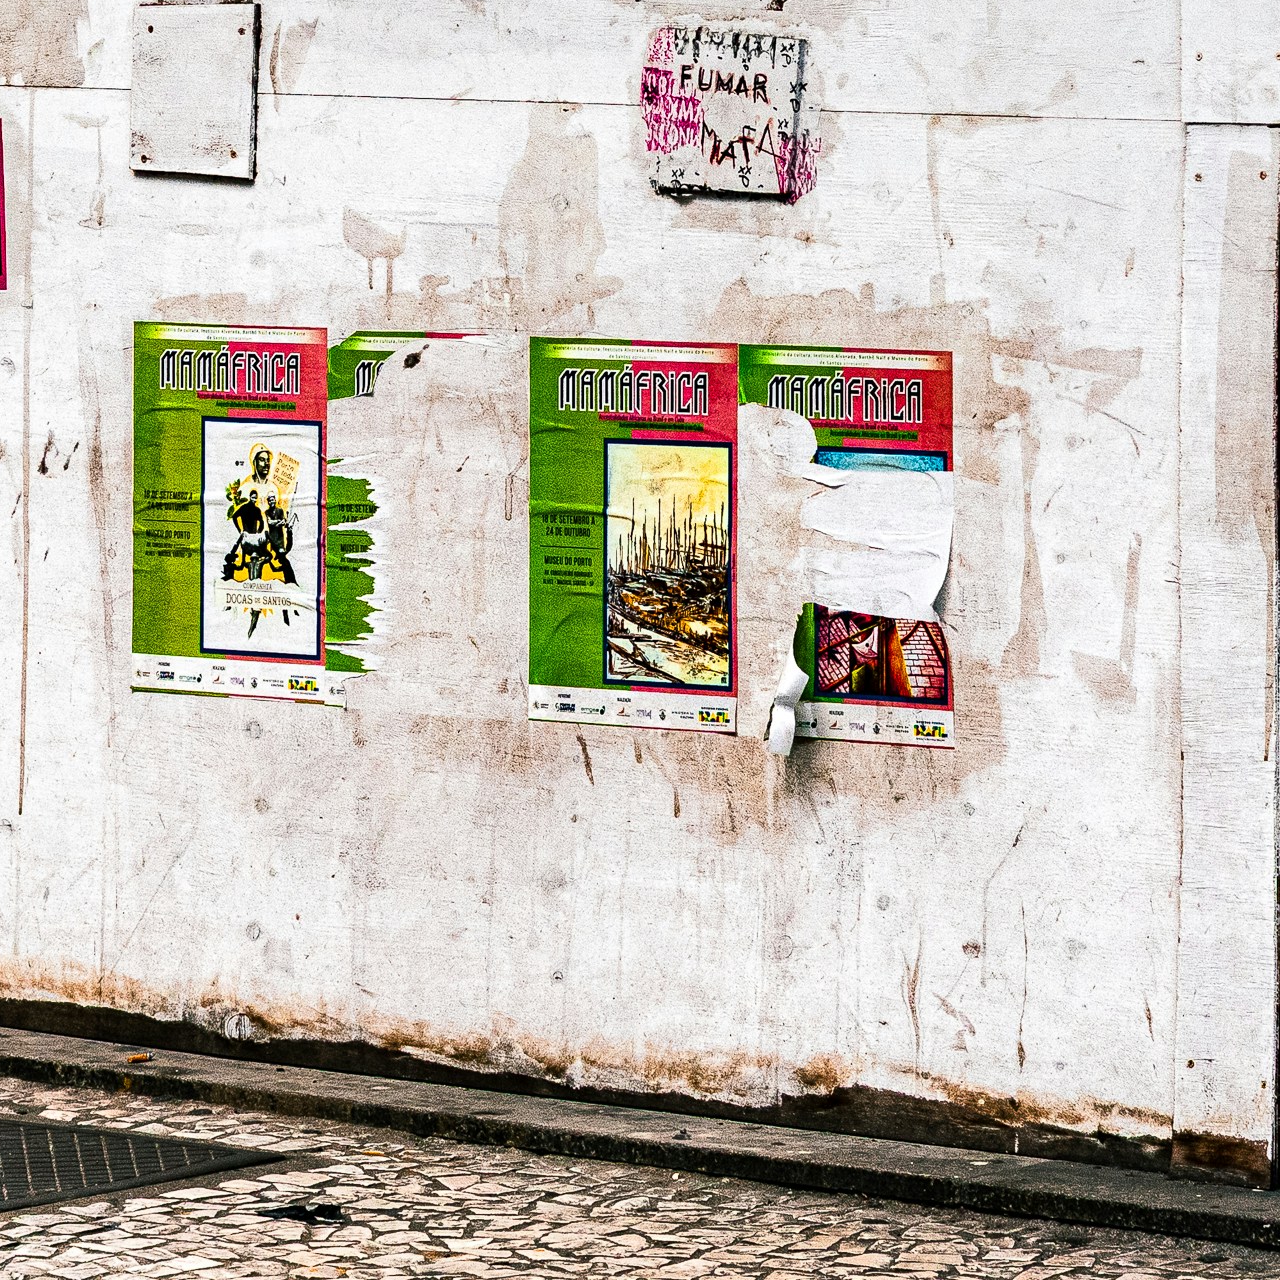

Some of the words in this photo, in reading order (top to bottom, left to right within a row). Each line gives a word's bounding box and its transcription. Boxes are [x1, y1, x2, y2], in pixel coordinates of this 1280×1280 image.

[681, 64, 771, 105] FUMAR
[226, 592, 253, 605] DOCAS
[262, 596, 292, 606] SANTOS
